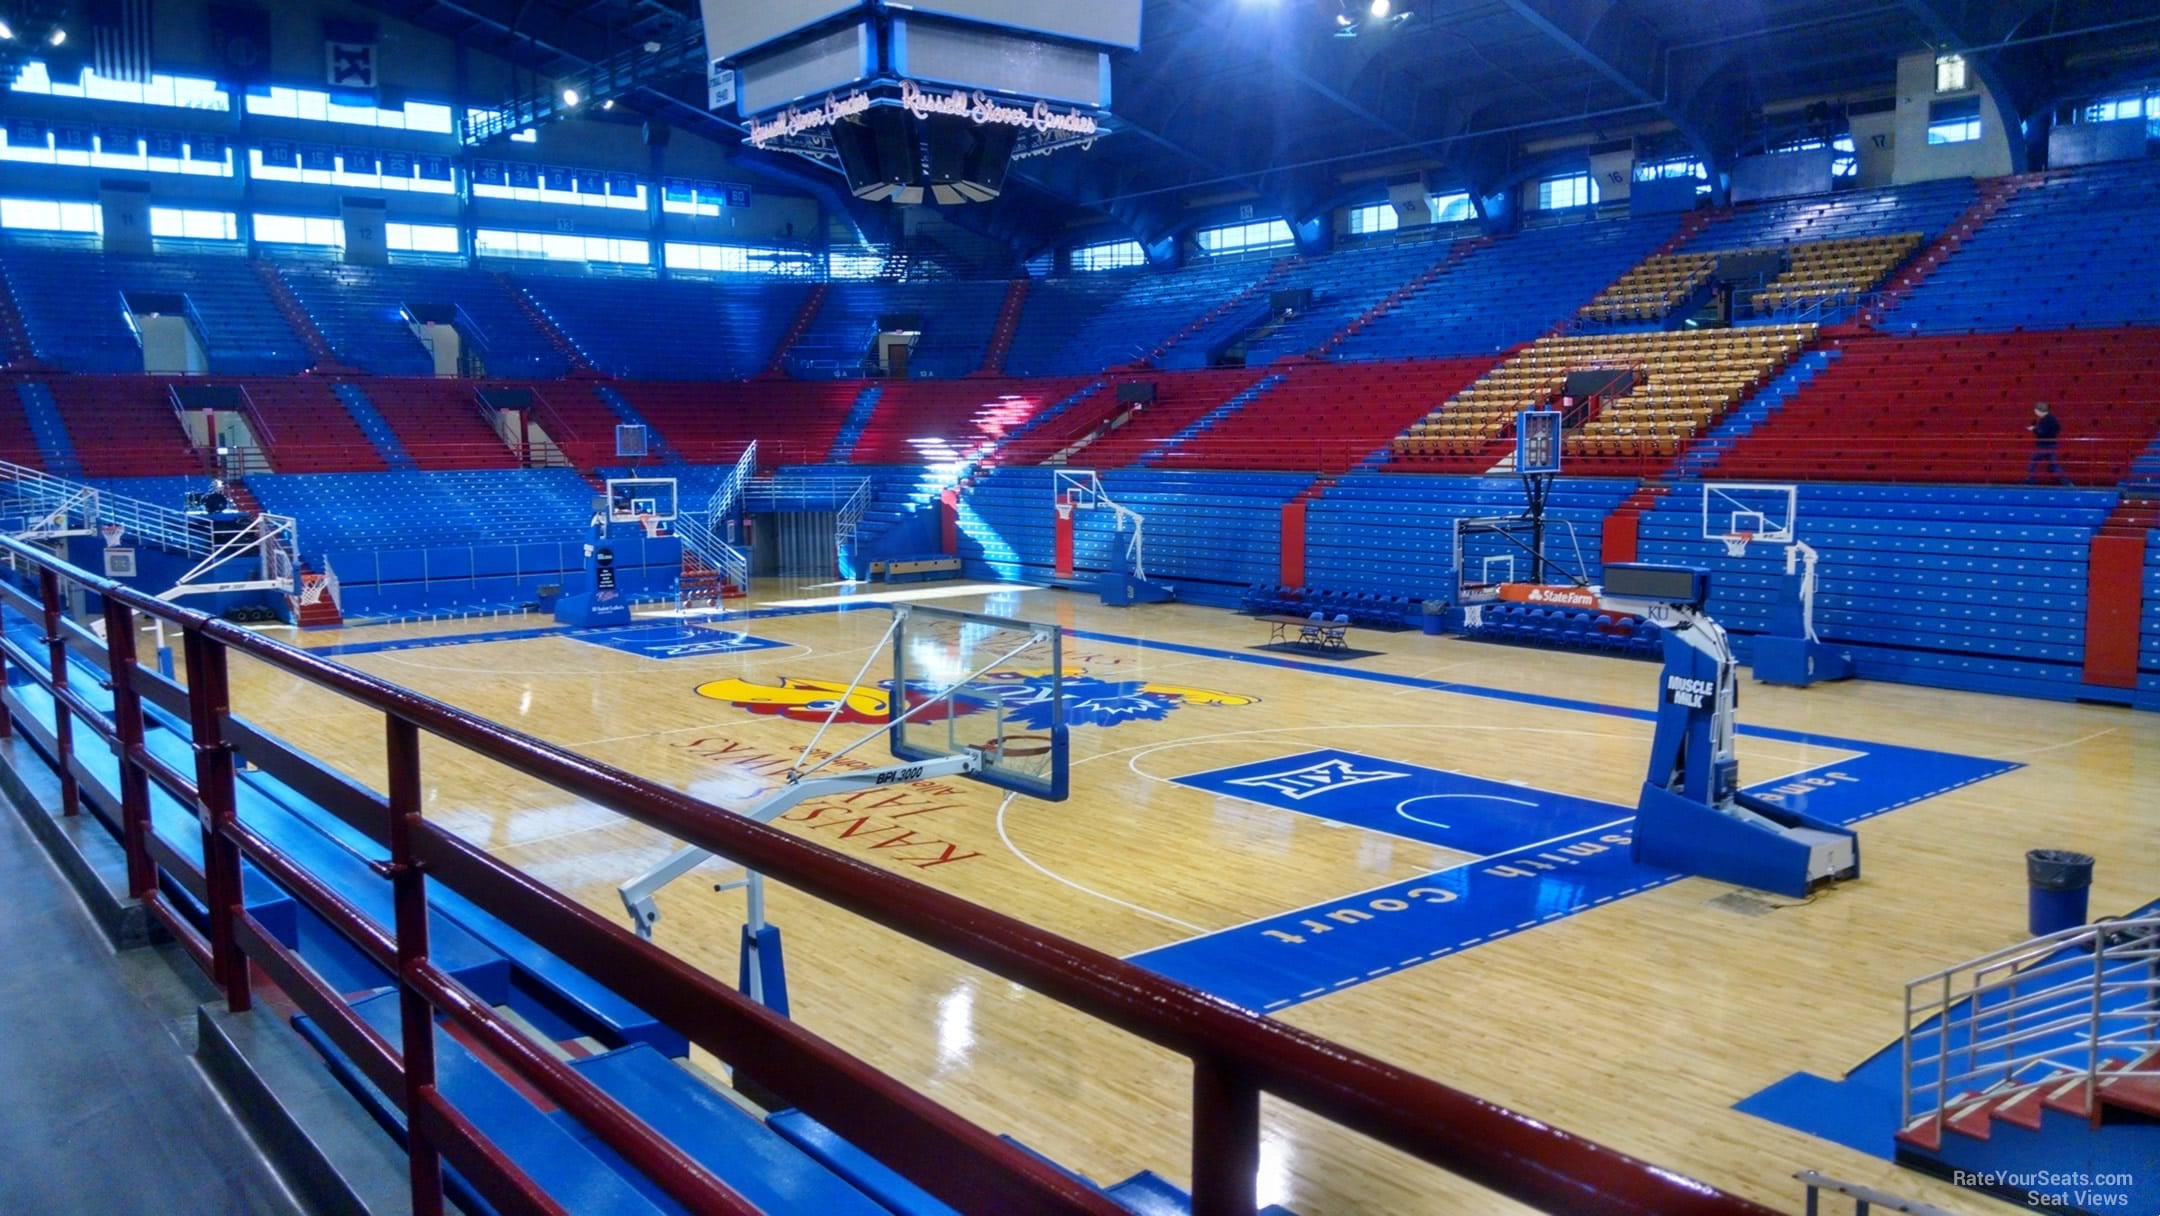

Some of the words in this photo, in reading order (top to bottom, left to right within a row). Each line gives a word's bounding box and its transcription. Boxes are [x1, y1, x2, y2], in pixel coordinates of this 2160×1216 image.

[900, 79, 969, 120] Russell
[971, 90, 1032, 128] Stover
[1032, 99, 1098, 134] Candies
[1872, 134, 1885, 147] 17
[514, 170, 530, 183] 34
[1608, 171, 1623, 184] 16
[359, 228, 373, 240] 12
[1648, 606, 1669, 620] KU
[1667, 675, 1714, 696] MUSCLE
[1673, 691, 1703, 709] MILK
[876, 771, 898, 785] BPI
[897, 767, 923, 781] 3000
[1752, 771, 1860, 801] Jame
[1481, 829, 1633, 878] smith
[1261, 886, 1458, 945] Court
